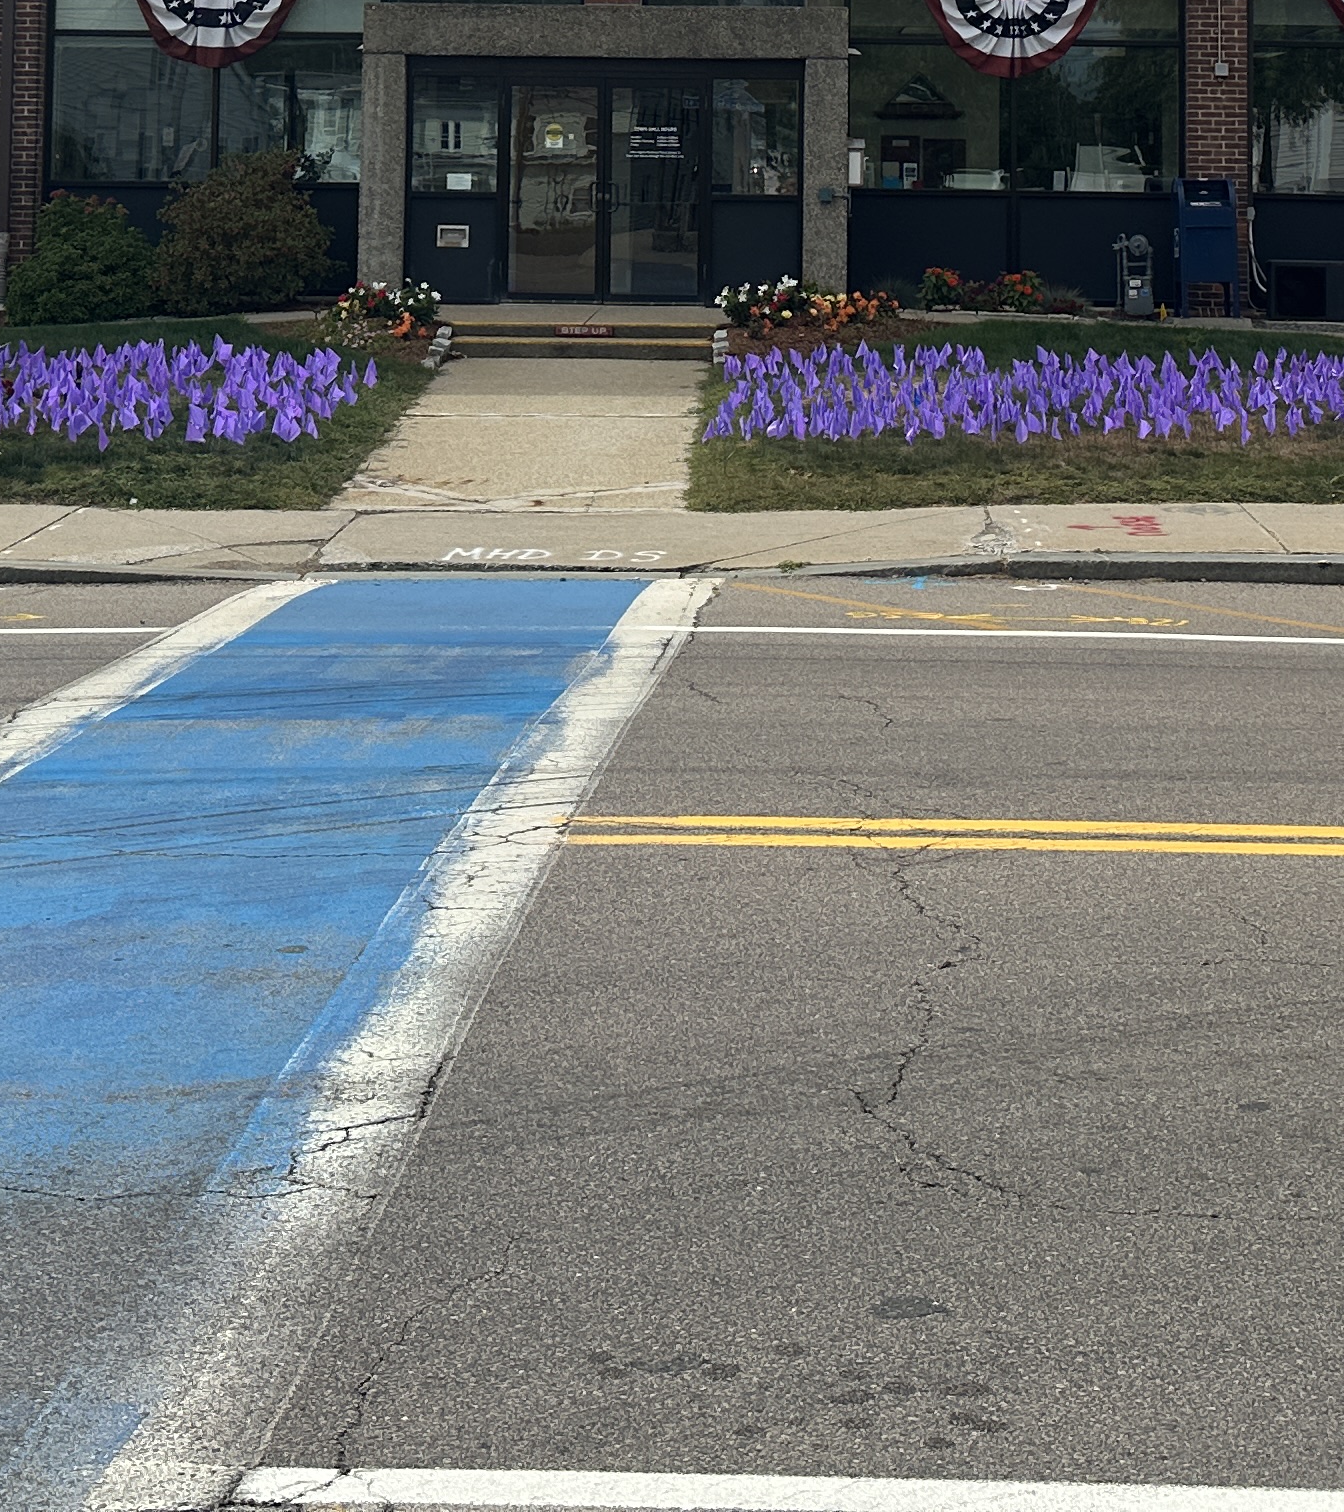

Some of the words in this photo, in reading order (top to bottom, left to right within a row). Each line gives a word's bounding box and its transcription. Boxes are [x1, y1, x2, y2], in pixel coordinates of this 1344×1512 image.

[561, 326, 589, 335] STEP
[591, 326, 607, 335] UP
[441, 546, 552, 562] MHD
[579, 548, 668, 563] DS
